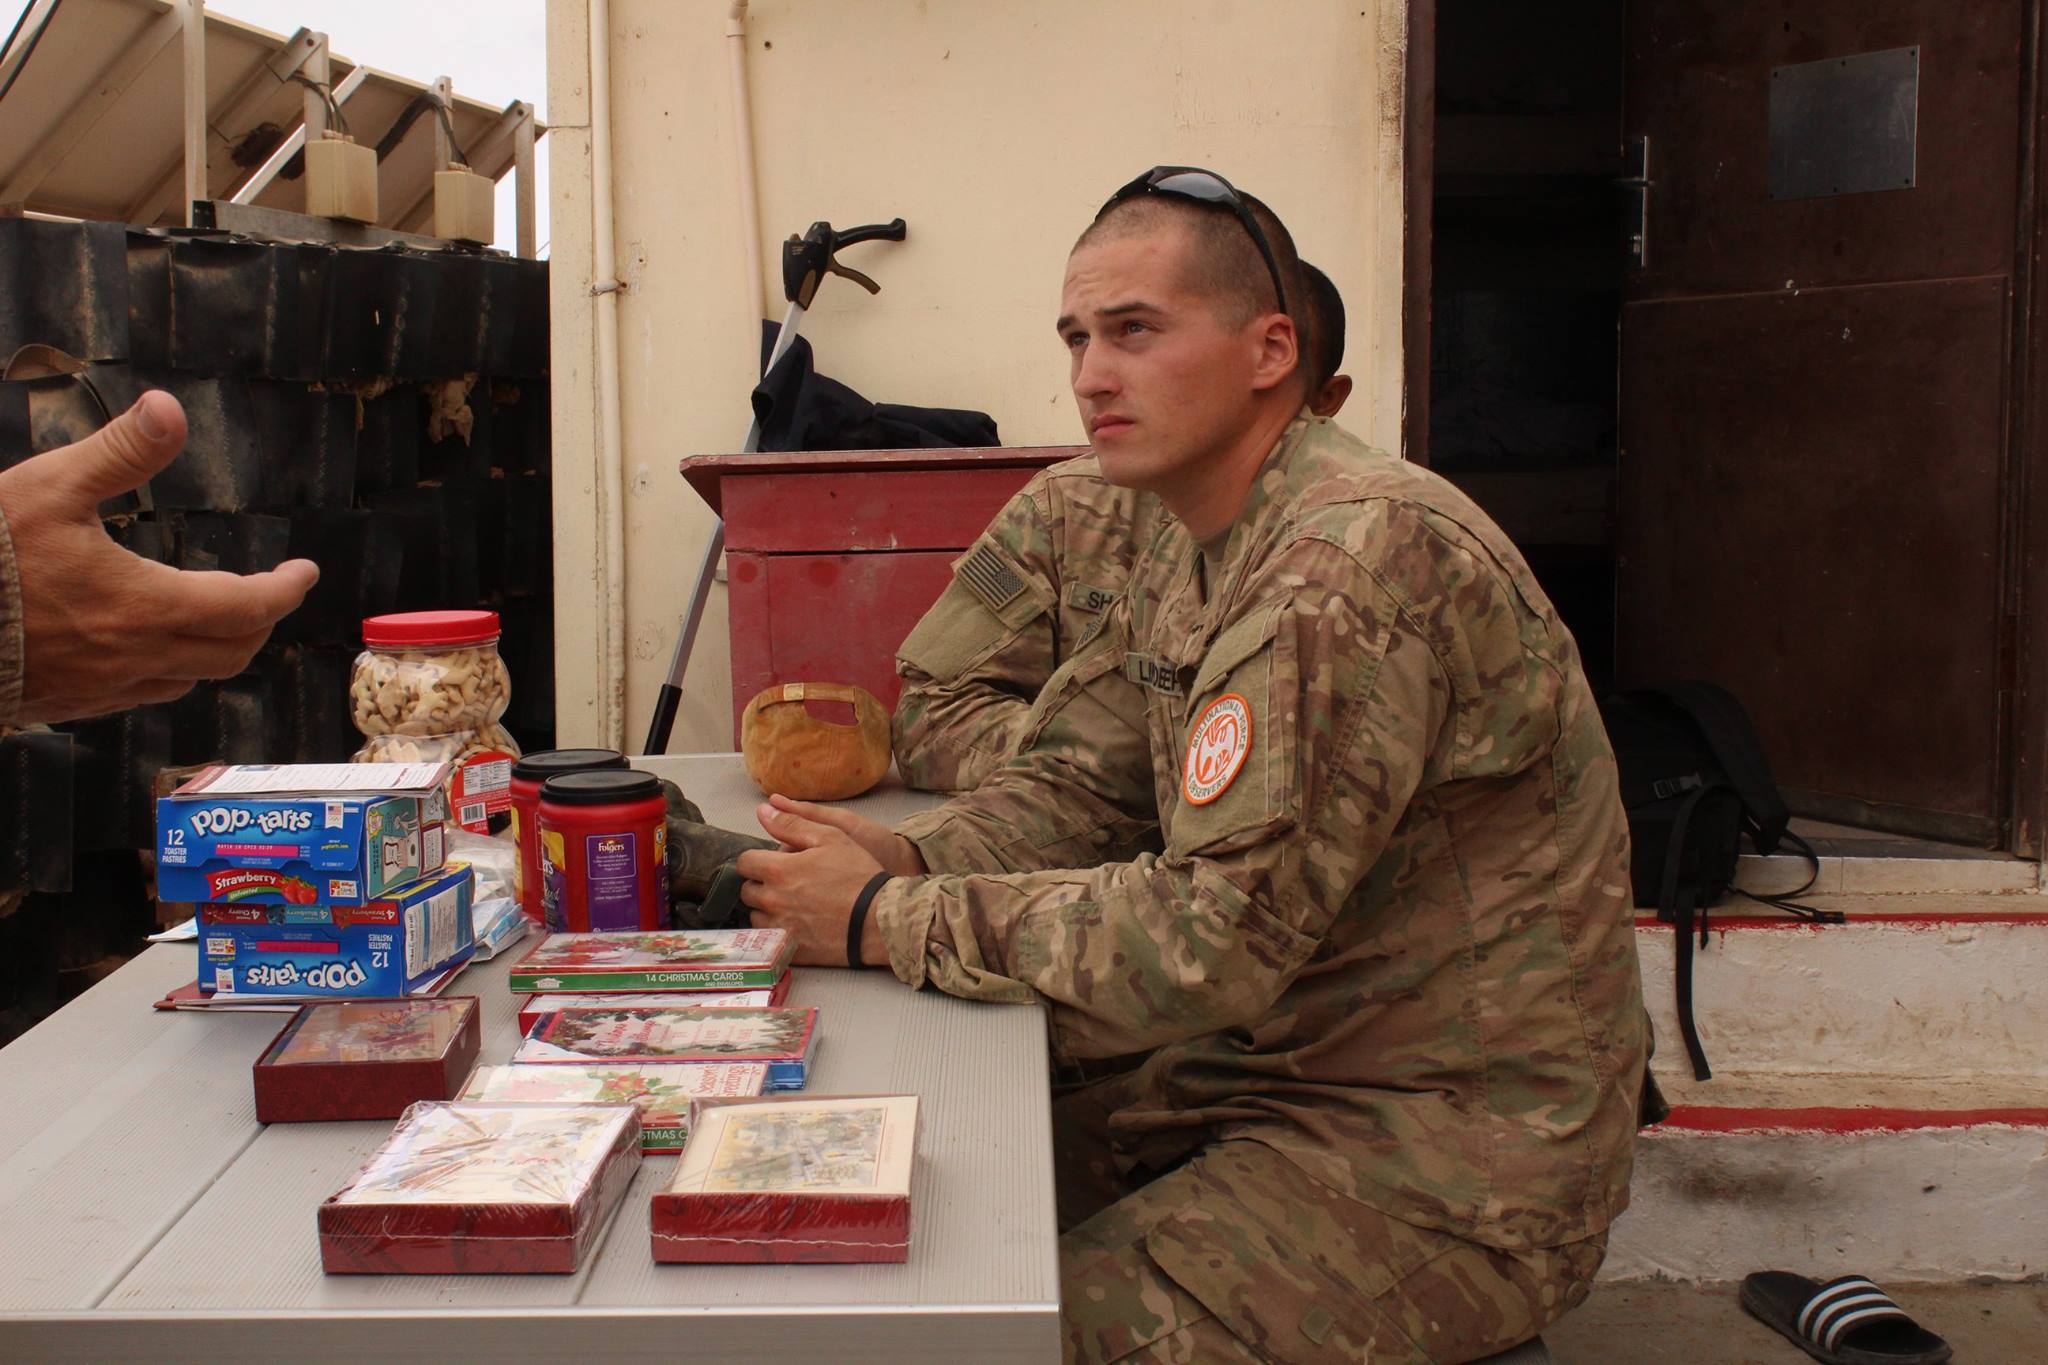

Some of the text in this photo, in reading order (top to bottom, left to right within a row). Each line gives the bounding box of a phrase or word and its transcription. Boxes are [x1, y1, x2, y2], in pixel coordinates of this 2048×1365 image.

[1192, 699, 1247, 751] MULTINATIONAL FORCE
[1188, 774, 1227, 798] OBSERVERS
[166, 829, 184, 846] 12
[164, 847, 187, 855] TOASTER
[598, 842, 625, 854] Folgers
[161, 855, 187, 864] PASTRIES
[215, 872, 277, 891] Strawberry
[251, 909, 260, 920] 4
[320, 909, 328, 920] 4
[387, 909, 395, 920] 4
[368, 933, 393, 941] PASTRIES
[368, 941, 391, 950] TOASTER
[372, 952, 389, 968] 12
[645, 972, 744, 983] 14 CHRISTMAS CARDS
